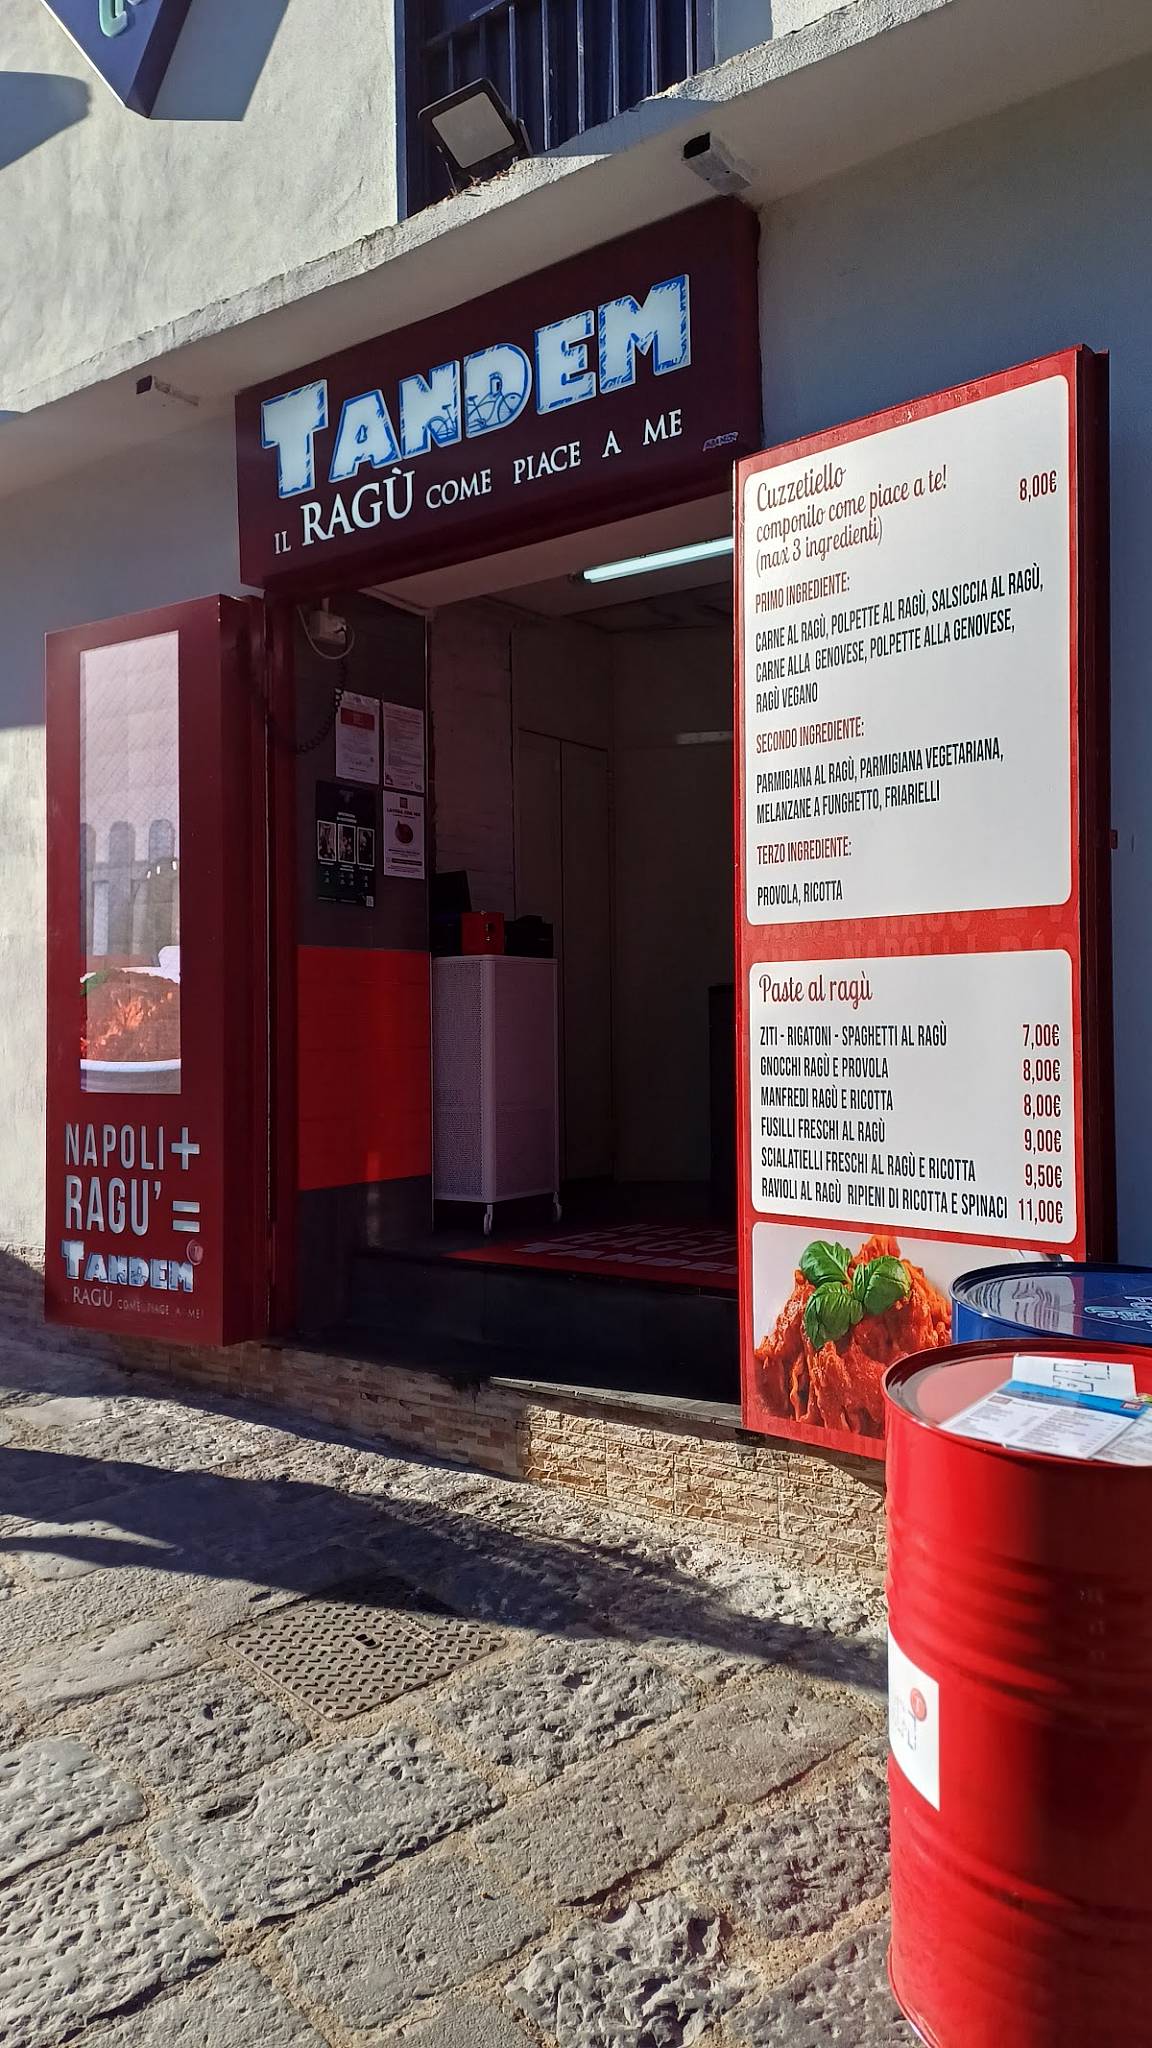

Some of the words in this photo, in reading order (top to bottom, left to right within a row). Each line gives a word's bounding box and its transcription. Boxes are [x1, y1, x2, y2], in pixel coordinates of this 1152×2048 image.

[261, 273, 692, 499] TANDEM
[274, 531, 291, 555] IL
[301, 467, 414, 547] RAGÙ
[425, 469, 492, 509] COME
[513, 441, 582, 484] PIACE
[601, 430, 621, 459] A
[642, 409, 683, 447] ME
[757, 462, 846, 511] Cuzzetiello
[1019, 470, 1057, 502] 8,00€
[756, 502, 825, 543] componilo
[829, 495, 866, 522] come
[869, 480, 909, 517] piace
[913, 481, 925, 497] a
[929, 465, 947, 492] te!
[756, 545, 789, 577] (max
[792, 539, 801, 562] 3
[806, 516, 883, 561] ingredienti)
[755, 590, 784, 613] PRIMO
[786, 571, 850, 606] INGREDIENTE:
[756, 627, 786, 652] CARNE
[787, 622, 798, 645] AL
[801, 608, 829, 642] RAGÙ,
[831, 605, 880, 637] POLPETTE
[882, 600, 895, 624] AL
[898, 590, 928, 620] RAGÙ,
[932, 579, 988, 611] SALSICCIA
[991, 574, 1005, 598] AL
[1008, 563, 1044, 592] RAGÙ,
[756, 657, 786, 683] CARNE
[787, 652, 811, 676] ALLA
[815, 641, 867, 671] GENOVESE,
[870, 627, 921, 658] POLPETTE
[924, 622, 951, 648] ALLA
[953, 608, 1015, 642] GENOVESE,
[756, 685, 780, 713] RAGÙ
[782, 682, 818, 709] VEGANO
[756, 727, 798, 754] SECONDO
[800, 716, 865, 747] INGREDIENTE:
[757, 766, 812, 794] PARMIGIANA
[814, 763, 827, 785] AL
[829, 756, 858, 782] RAGÙ,
[860, 749, 924, 780] PARMIGIANA
[925, 737, 1004, 770] VEGETARIANA,
[757, 798, 812, 825] MELANZANE
[813, 796, 821, 817] A
[823, 789, 882, 815] FUNGHETTO,
[885, 780, 941, 808] FRIARIELLI
[757, 843, 786, 865] TERZO
[788, 836, 852, 863] INGREDIENTE:
[757, 883, 801, 907] PROVOLA,
[803, 880, 843, 903] RICOTTA
[759, 974, 804, 1003] Paste
[808, 974, 826, 1001] al
[829, 970, 873, 1009] ragù
[760, 1026, 778, 1046] ZITI
[787, 1025, 832, 1046] RIGATONI
[842, 1025, 898, 1047] SPAGHETTI
[901, 1025, 916, 1046] AL
[918, 1020, 947, 1047] RAGÙ
[1022, 1023, 1060, 1050] 7,00€
[760, 1056, 801, 1077] GNOCCHI
[803, 1052, 830, 1078] RAGÙ
[833, 1057, 839, 1078] E
[842, 1057, 889, 1079] PROVOLA
[1023, 1059, 1061, 1085] 8,00€
[760, 1086, 809, 1108] MANFREDI
[811, 1084, 838, 1110] RAGÙ
[841, 1088, 847, 1110] E
[850, 1088, 894, 1111] RICOTTA
[1023, 1093, 1062, 1120] 8,00€
[65, 1122, 164, 1170] NAPOLI
[761, 1117, 795, 1138] FUSILLI
[798, 1118, 839, 1141] FRESCHI
[841, 1120, 855, 1141] AL
[857, 1117, 885, 1143] RAGÙ
[1024, 1128, 1062, 1155] 9,00€
[761, 1147, 823, 1171] SCIALATIELLI
[825, 1150, 868, 1174] FRESCHI
[870, 1153, 884, 1175] AL
[887, 1152, 915, 1178] RAGÙ
[919, 1157, 925, 1178] E
[928, 1158, 976, 1183] RICOTTA
[1024, 1164, 1063, 1190] 9,50€
[761, 1178, 798, 1199] RAVIOLI
[800, 1180, 812, 1201] AL
[815, 1178, 841, 1203] RAGÙ
[848, 1184, 886, 1209] RIPIENI
[888, 1187, 899, 1209] DI
[902, 1189, 948, 1214] RICOTTA
[951, 1192, 958, 1214] E
[961, 1194, 1008, 1220] SPINACI
[1018, 1199, 1063, 1225] 11,00€
[61, 1240, 194, 1293] TANDEM
[73, 1286, 113, 1308] RAGÙ
